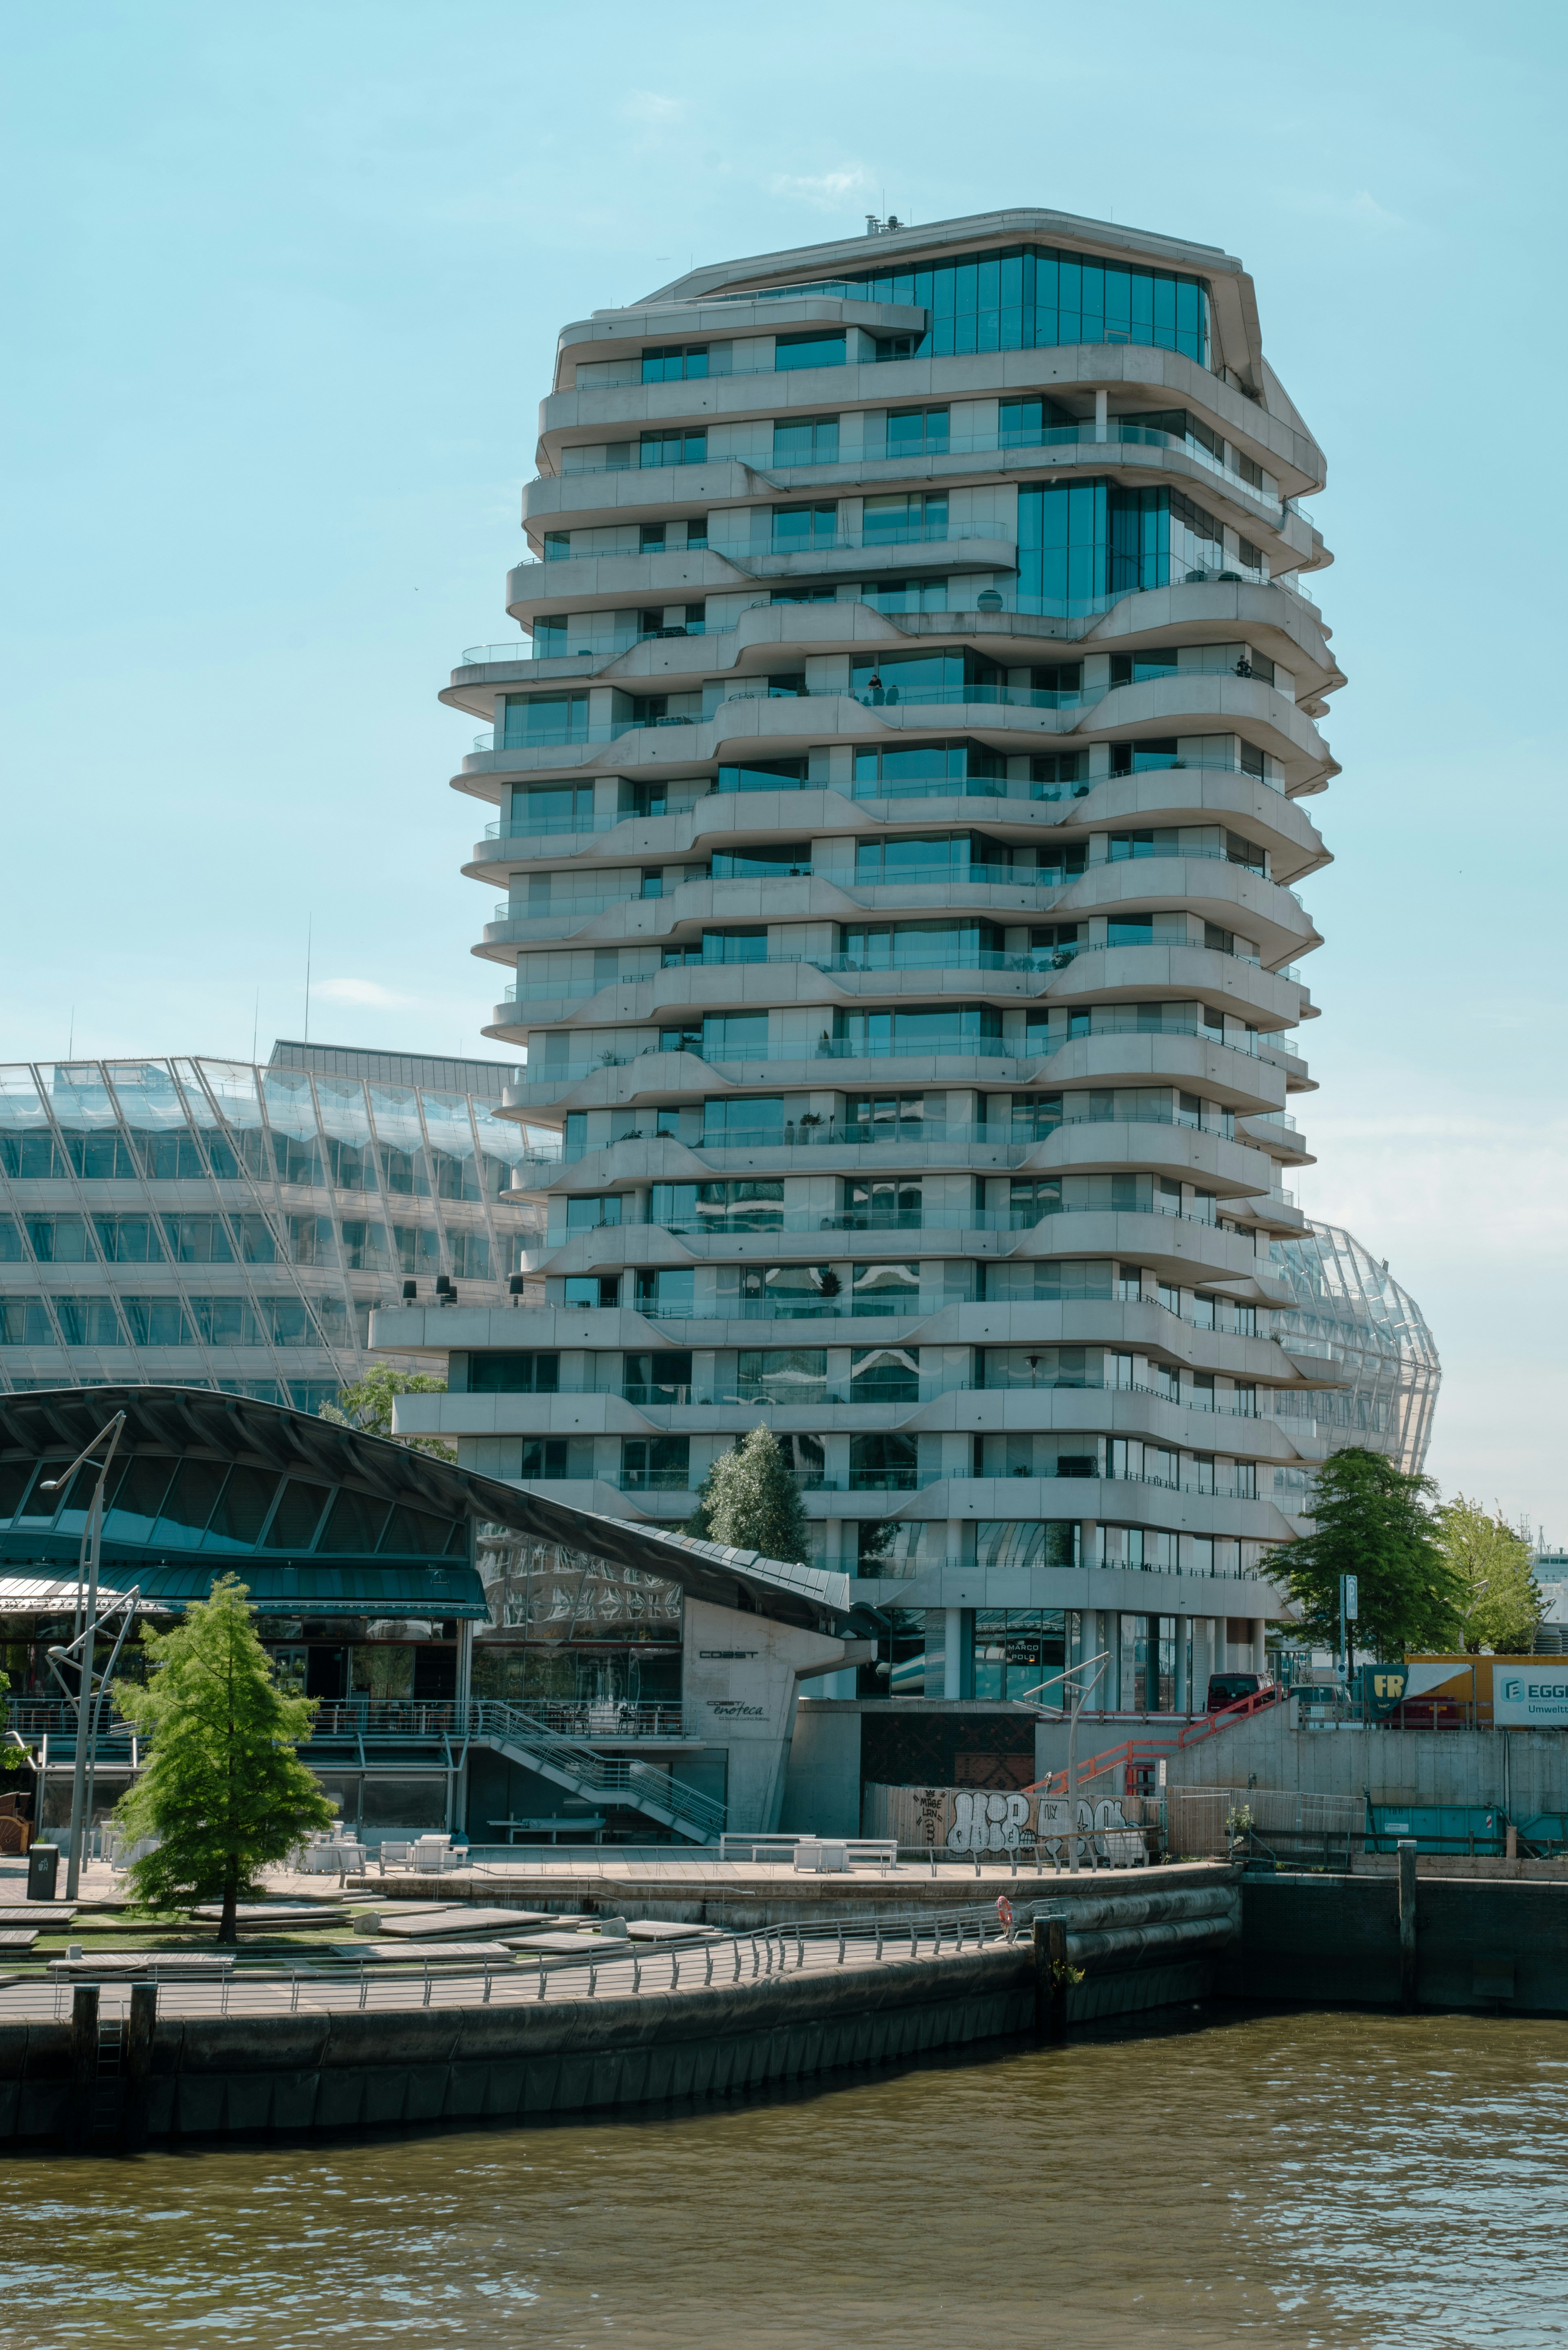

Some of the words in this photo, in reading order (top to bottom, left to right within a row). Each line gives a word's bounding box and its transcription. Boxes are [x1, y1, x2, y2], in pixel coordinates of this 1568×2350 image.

[1374, 1675, 1404, 1697] FR
[1528, 1685, 1568, 1697] EGG
[714, 1701, 763, 1716] enoteca
